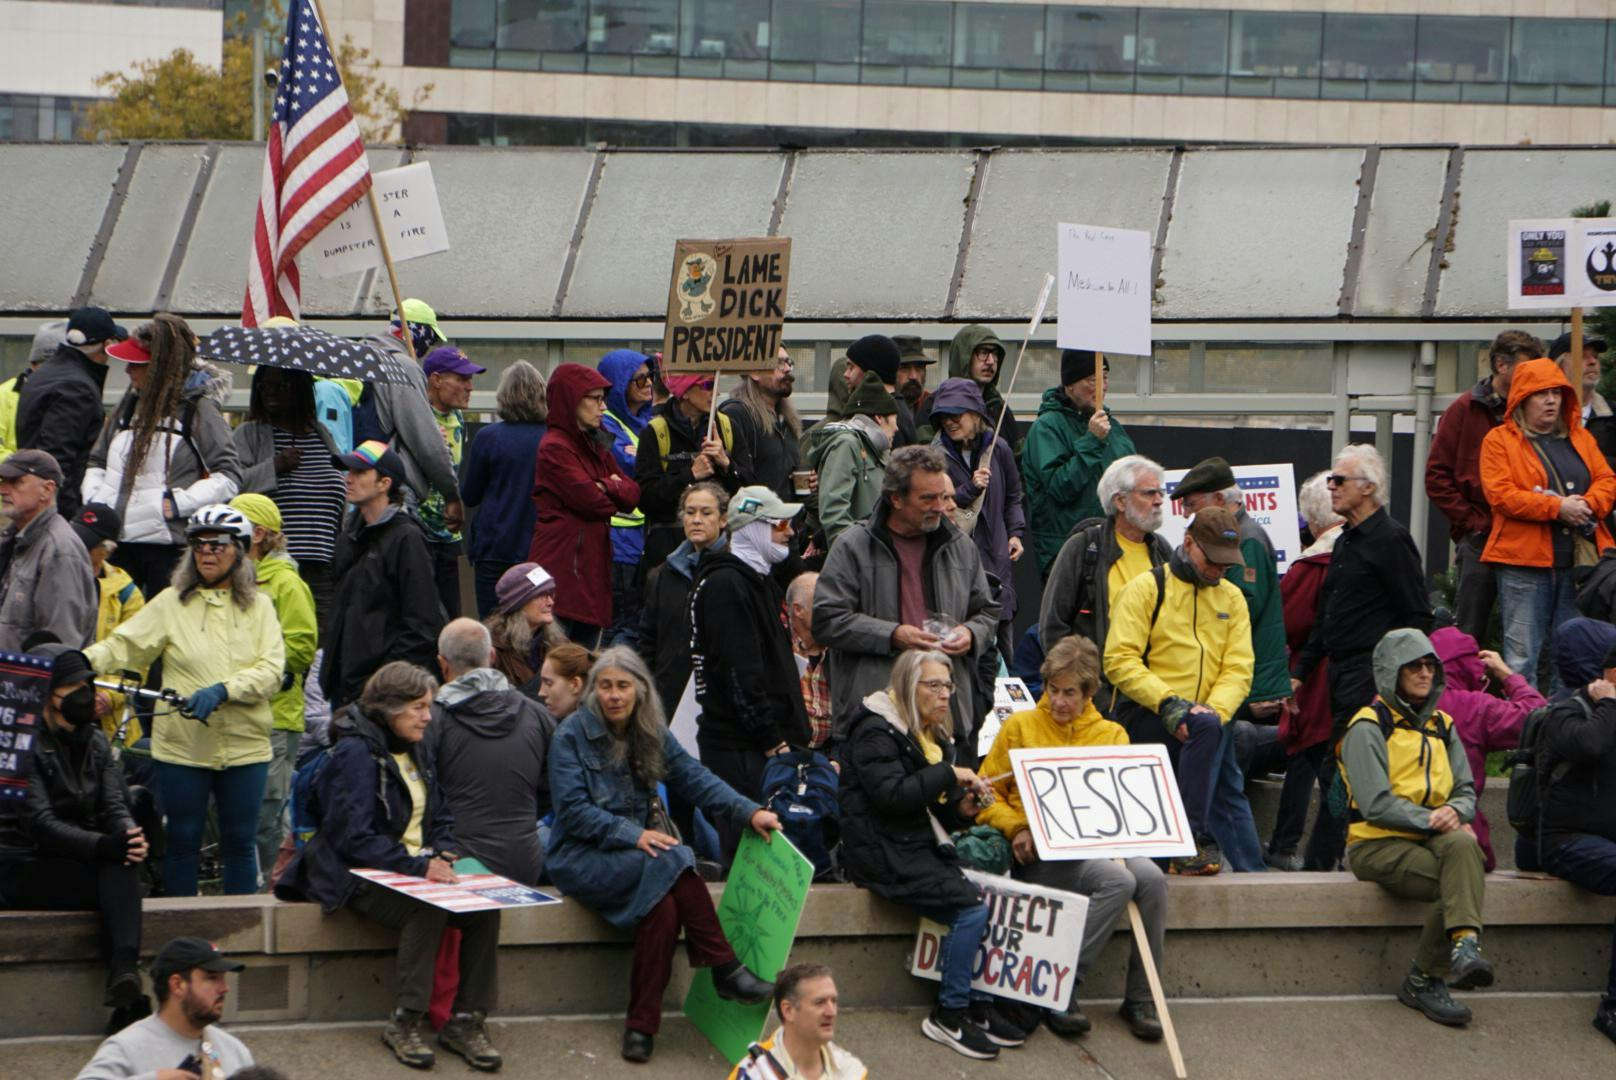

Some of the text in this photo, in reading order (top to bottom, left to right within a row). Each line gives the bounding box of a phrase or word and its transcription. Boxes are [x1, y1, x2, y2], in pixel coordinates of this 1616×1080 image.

[393, 209, 401, 218] A
[323, 225, 426, 258] DUMPSTER FIRE
[1522, 230, 1565, 241] ONLY YOU
[722, 253, 783, 285] LAME
[720, 287, 783, 319] DICK
[671, 324, 783, 363] PRESIDENT
[1028, 763, 1172, 841] RESIST
[980, 885, 1064, 938] OTECT
[917, 931, 1070, 1002] DOCRACY
